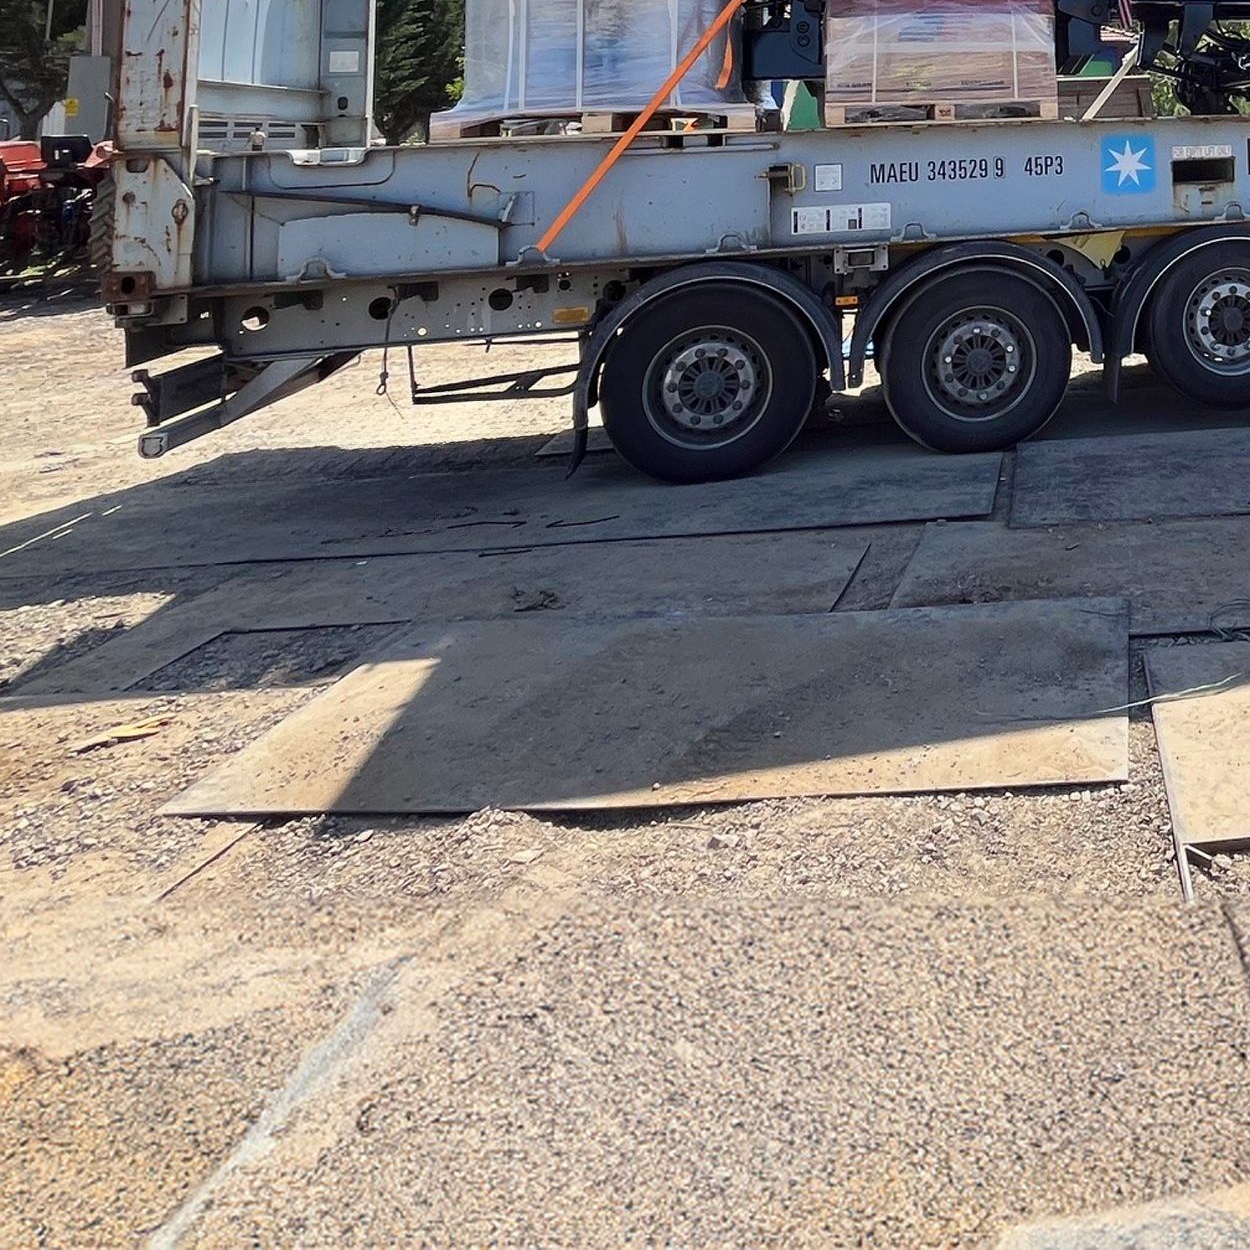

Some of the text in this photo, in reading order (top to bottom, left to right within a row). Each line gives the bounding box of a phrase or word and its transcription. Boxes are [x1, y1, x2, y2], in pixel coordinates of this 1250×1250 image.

[870, 155, 1064, 183] MAEU 343529 9 45P3
